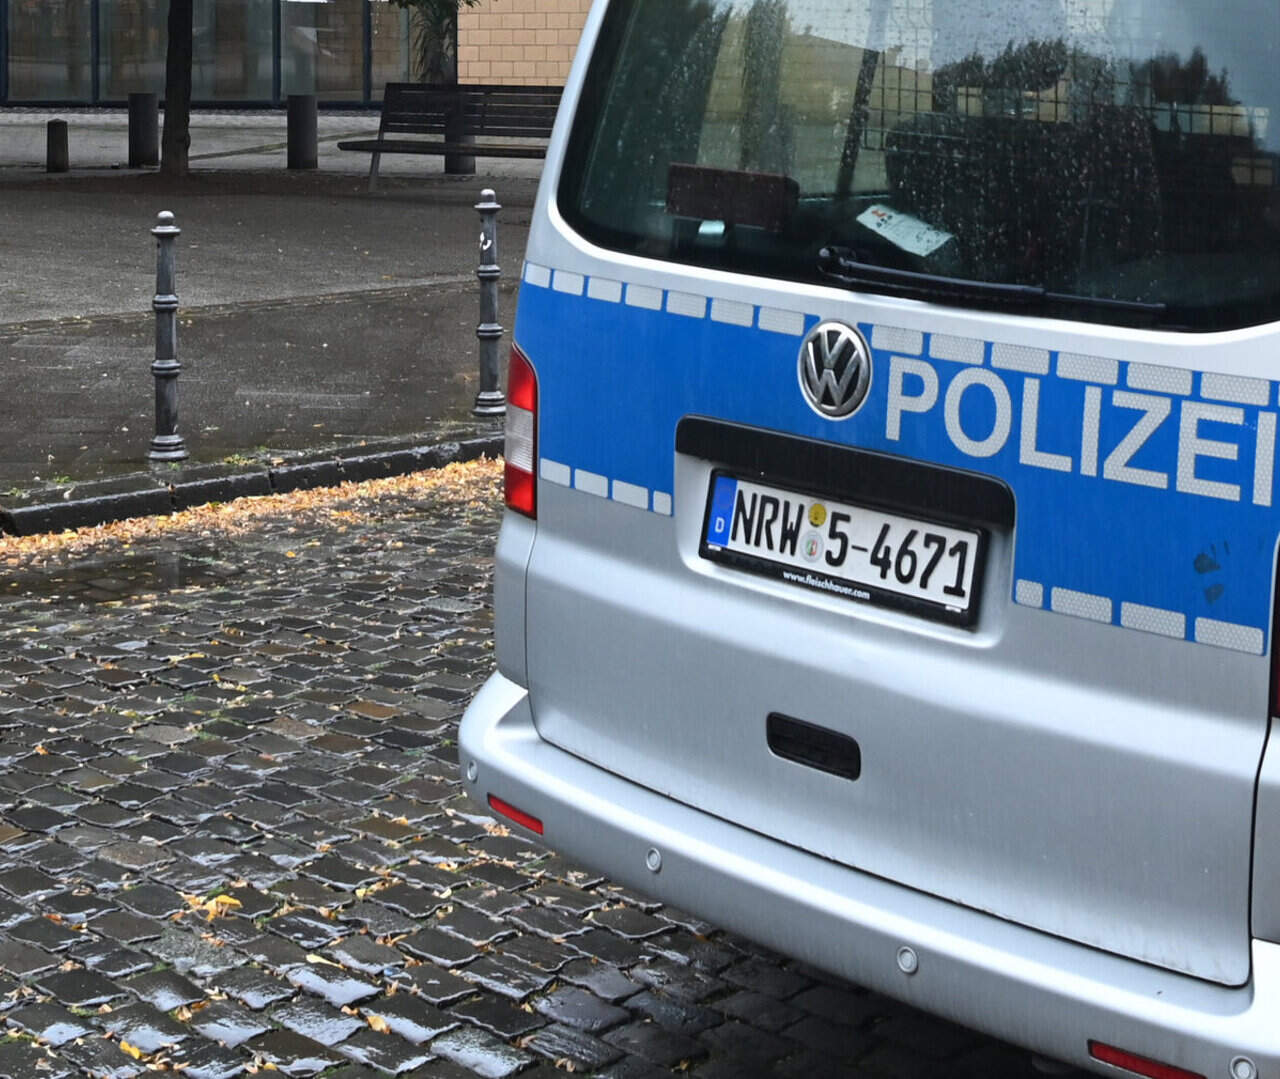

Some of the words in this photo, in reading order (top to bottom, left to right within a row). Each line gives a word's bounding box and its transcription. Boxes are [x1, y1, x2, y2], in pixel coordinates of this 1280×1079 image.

[885, 355, 1277, 507] POLIZEI
[715, 517, 725, 533] D
[731, 489, 805, 557] NRW
[825, 511, 969, 598] 5-4671
[783, 571, 871, 600] www.fleischhauer.com
